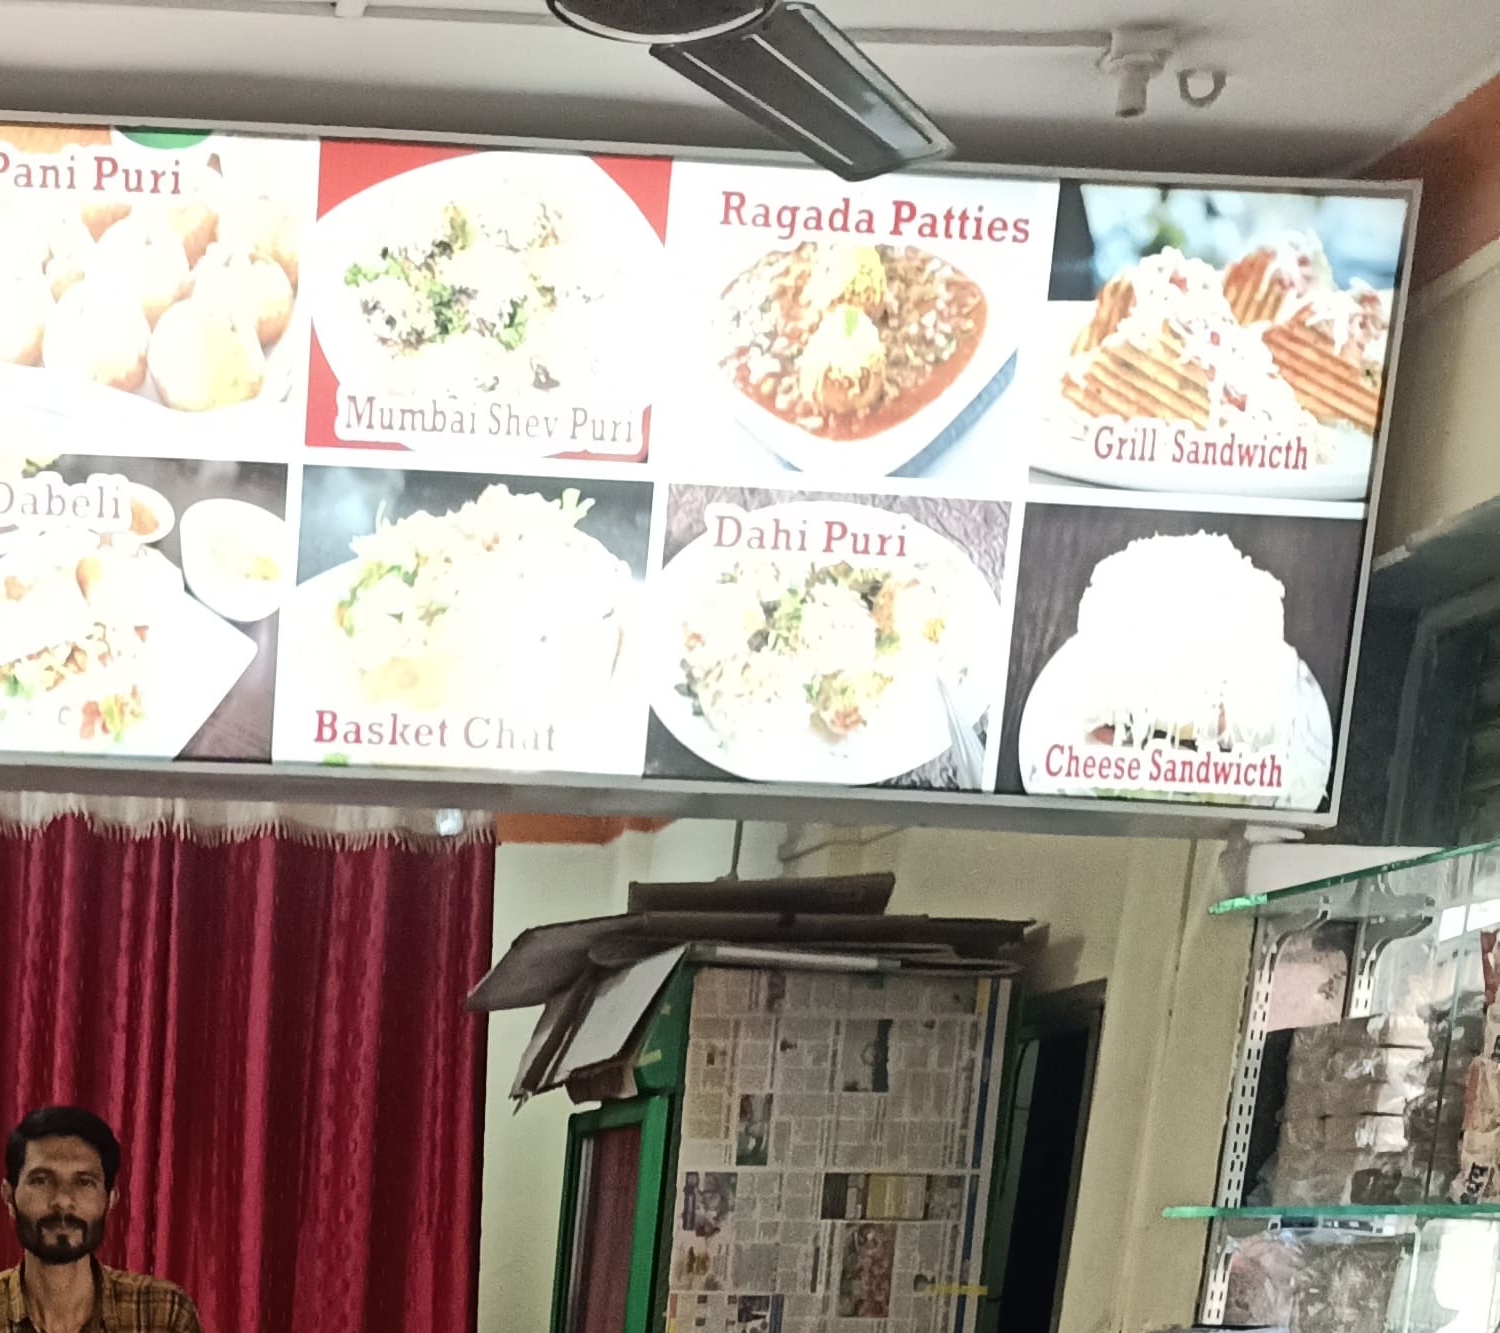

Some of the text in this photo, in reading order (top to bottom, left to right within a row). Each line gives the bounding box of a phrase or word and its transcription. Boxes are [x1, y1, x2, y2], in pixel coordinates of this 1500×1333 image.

[92, 156, 182, 195] Puri
[719, 190, 1031, 245] Ragada Patties
[344, 395, 633, 444] Mumbai Shev Puri
[1094, 426, 1309, 471] Grill Sandwicth
[713, 514, 908, 557] Dahi Puri
[314, 710, 556, 752] Basket Chat
[1045, 743, 1283, 788] Cheese Sandwicth
